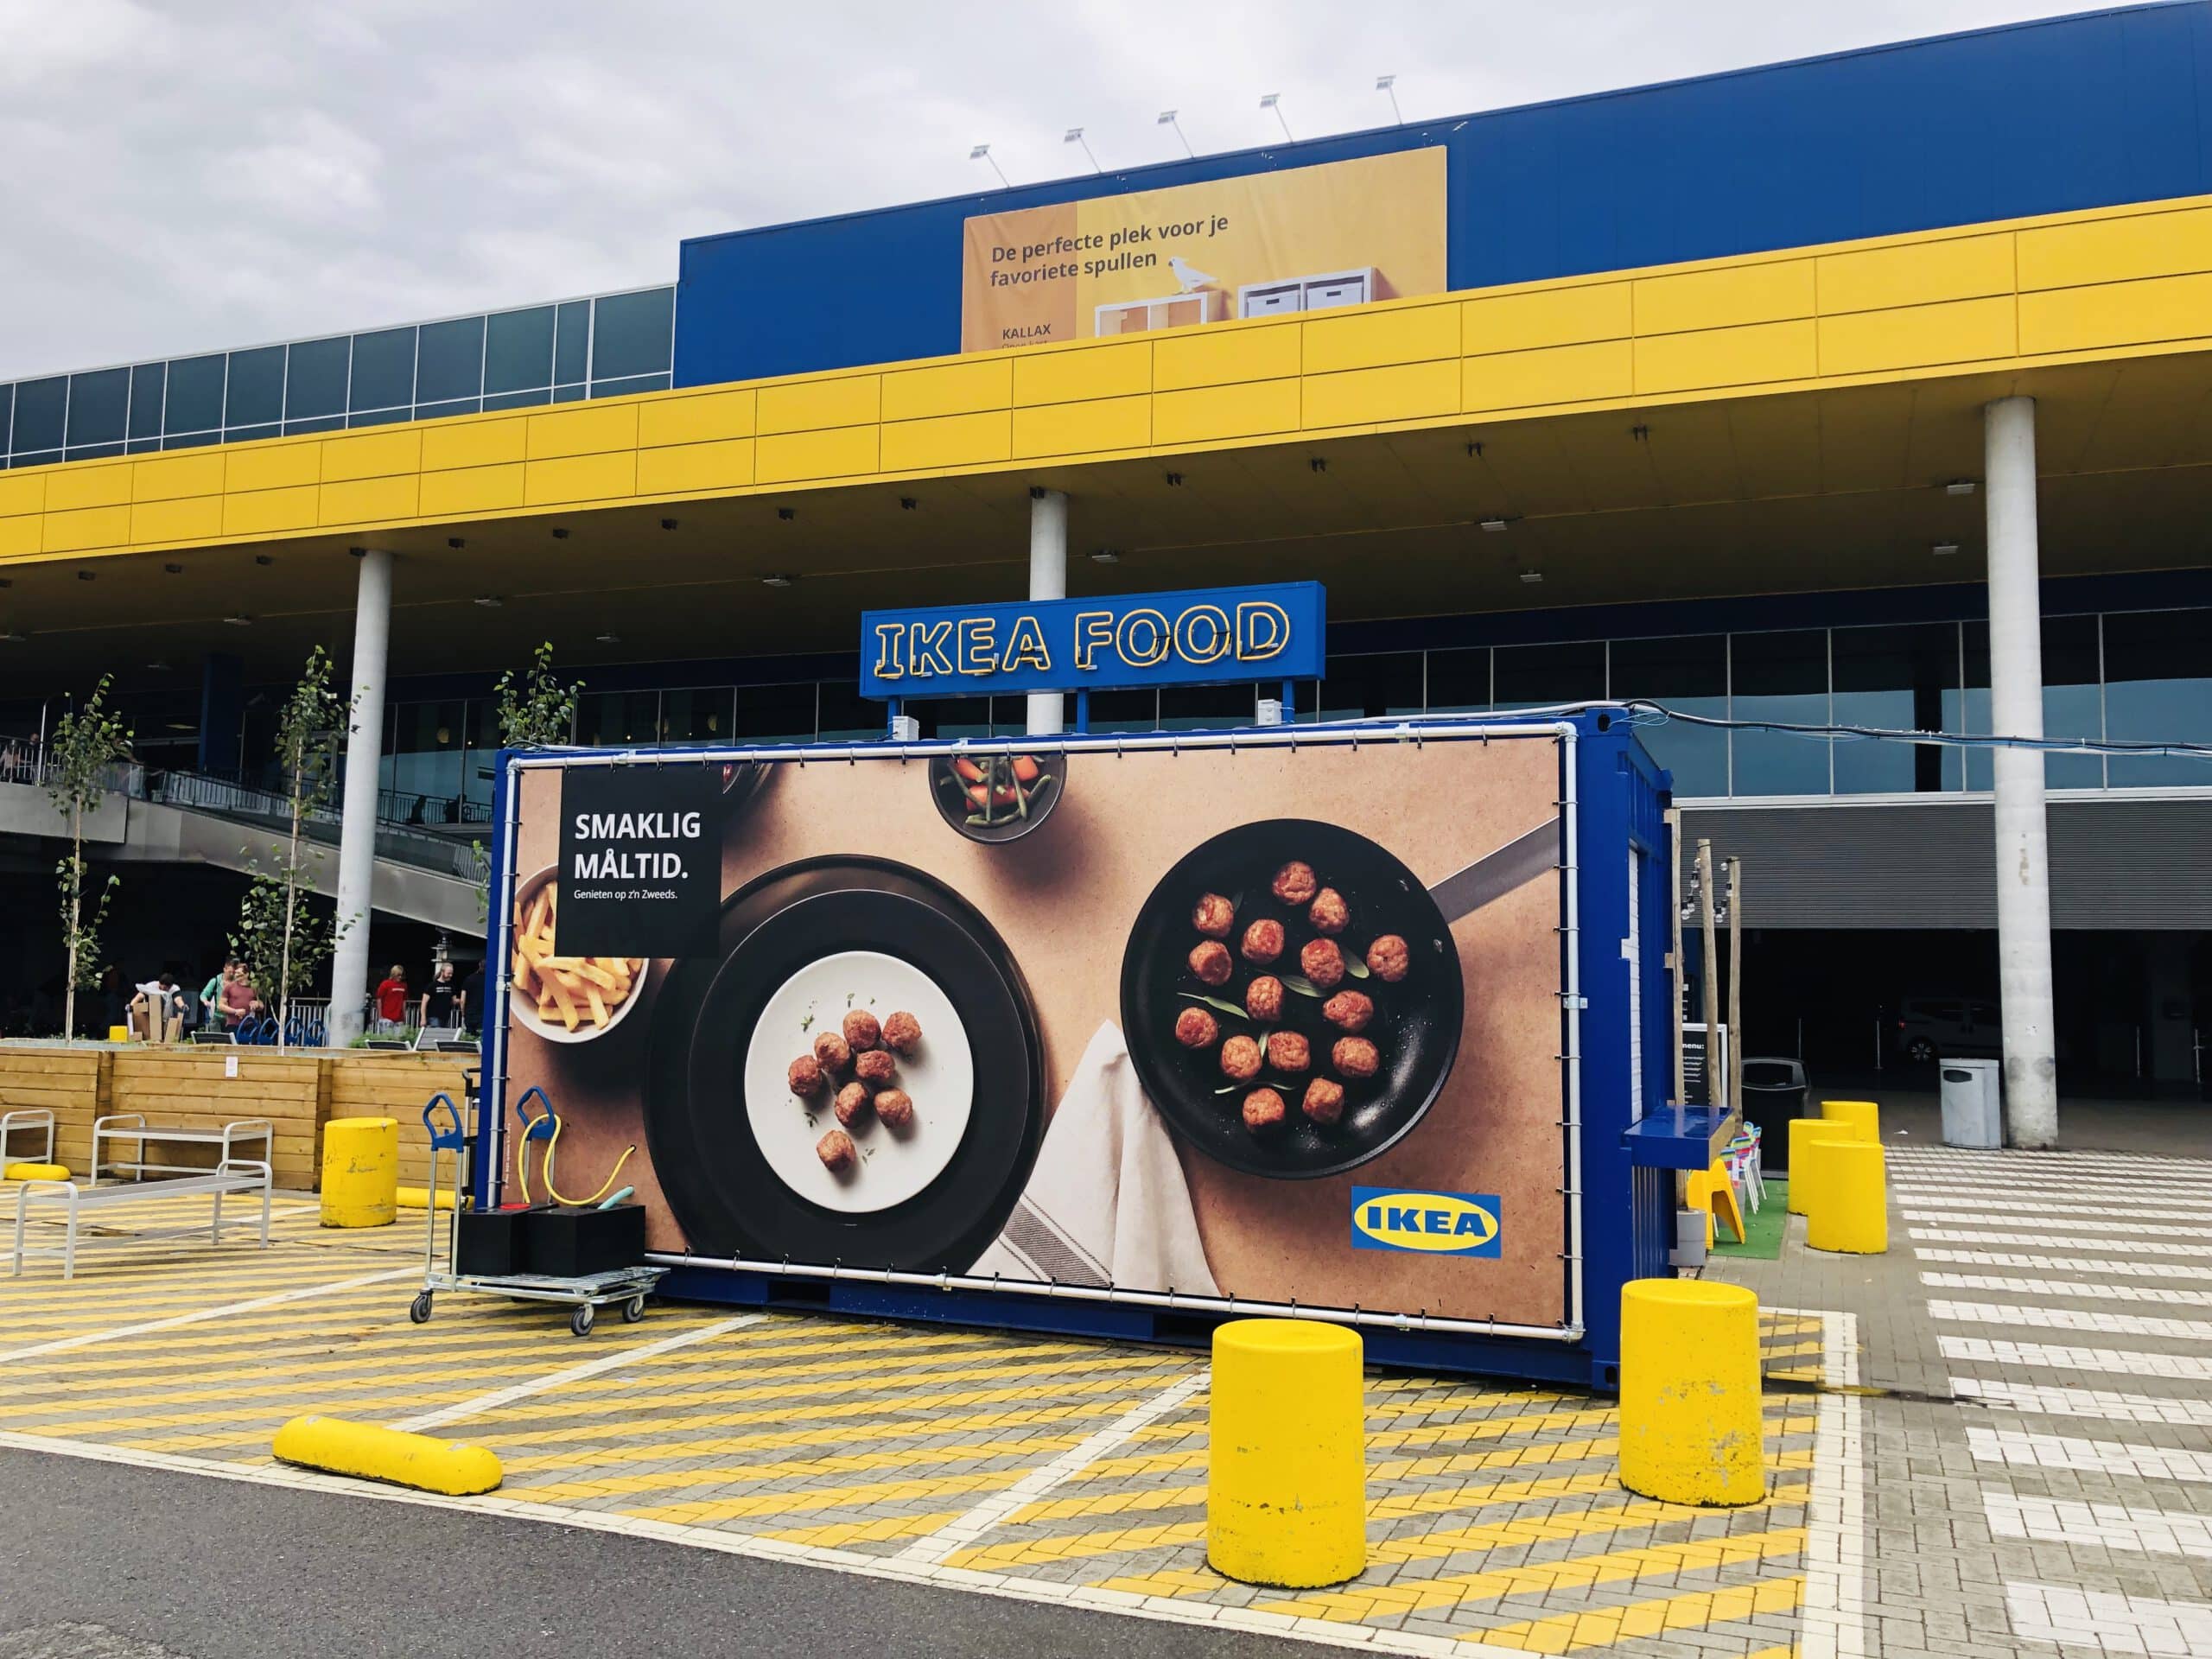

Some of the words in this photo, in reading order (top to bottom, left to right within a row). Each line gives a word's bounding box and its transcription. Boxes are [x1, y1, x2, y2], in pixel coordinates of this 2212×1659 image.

[992, 246, 1017, 263] De
[1022, 234, 1103, 264] perfecte
[1109, 225, 1152, 251] plek
[1158, 220, 1205, 239] voor
[1208, 214, 1229, 238] je
[990, 262, 1079, 287] favoriete
[1084, 251, 1157, 278] spullen
[1002, 323, 1052, 340] KALLAX
[874, 615, 1052, 678] IKEA
[1074, 601, 1290, 670] FOOD
[575, 811, 701, 840] SMAKLIG
[574, 848, 689, 879] MÅLTID.
[574, 890, 613, 899] Genieten
[614, 891, 626, 901] op
[641, 889, 678, 899] Zweeds.
[1367, 1206, 1488, 1238] IKEA
